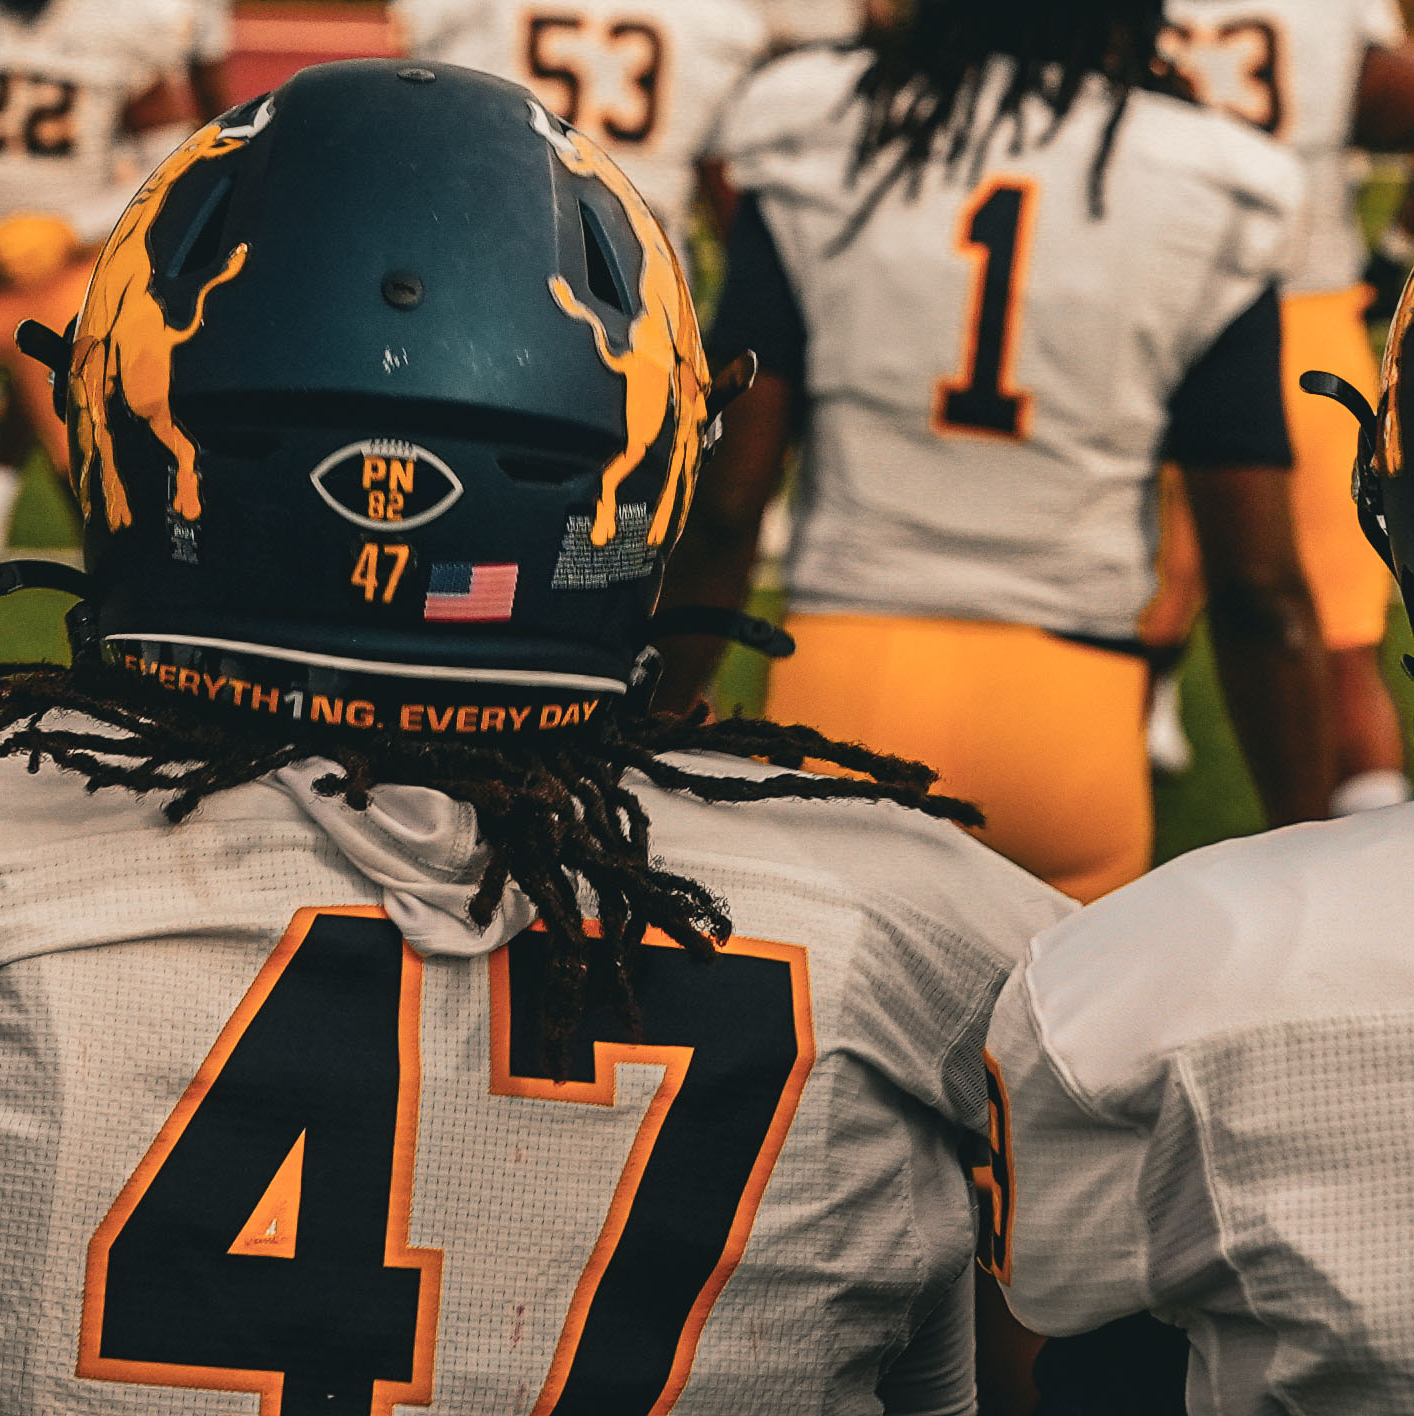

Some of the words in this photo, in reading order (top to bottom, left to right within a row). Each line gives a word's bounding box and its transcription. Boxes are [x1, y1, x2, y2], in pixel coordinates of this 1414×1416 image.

[521, 4, 669, 146] 53
[930, 172, 1041, 440] 1
[362, 456, 415, 494] PN
[368, 490, 405, 522] 82
[350, 541, 410, 603] 47
[400, 703, 532, 733] EVERY
[538, 697, 600, 731] DAY
[75, 903, 815, 1416] 47
